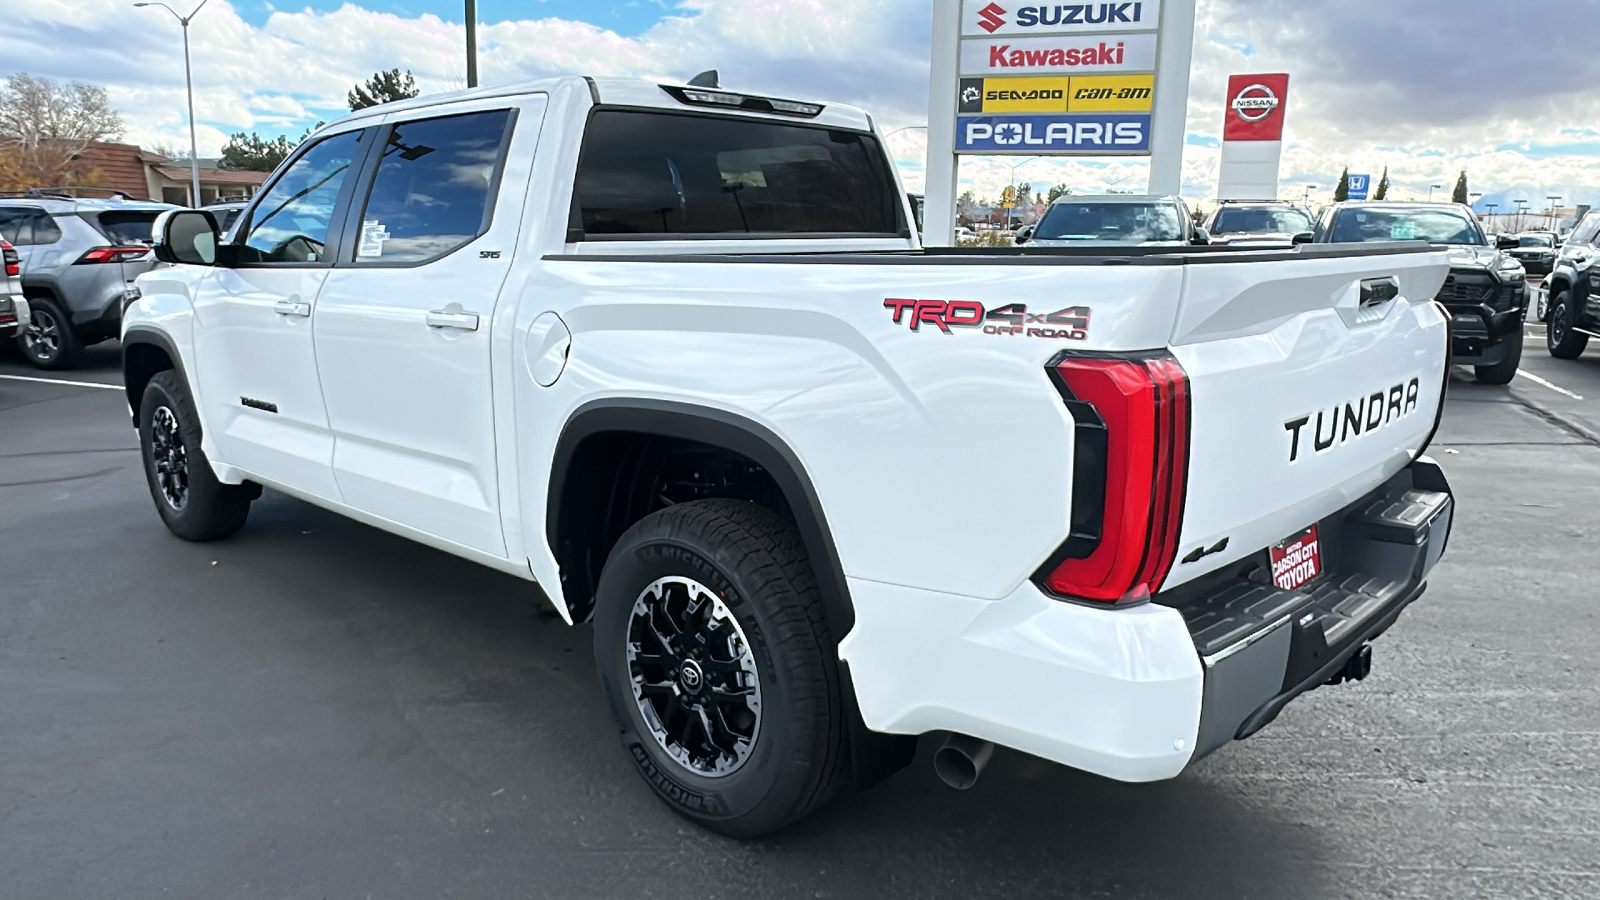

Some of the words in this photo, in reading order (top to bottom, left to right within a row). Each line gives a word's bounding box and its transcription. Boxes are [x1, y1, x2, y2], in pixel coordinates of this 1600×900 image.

[1016, 2, 1142, 27] SUZUKI
[989, 42, 1125, 68] Kawasaki
[1236, 99, 1274, 107] NISSAN
[965, 122, 1143, 145] POLARIS
[883, 297, 986, 335] TRD
[983, 325, 1024, 336] OFF
[1026, 327, 1089, 341] ROAD
[1284, 376, 1420, 463] TUNDRA
[1273, 549, 1302, 578] CARSON
[1302, 540, 1318, 561] CITY
[1278, 558, 1316, 590] TOYOTA
